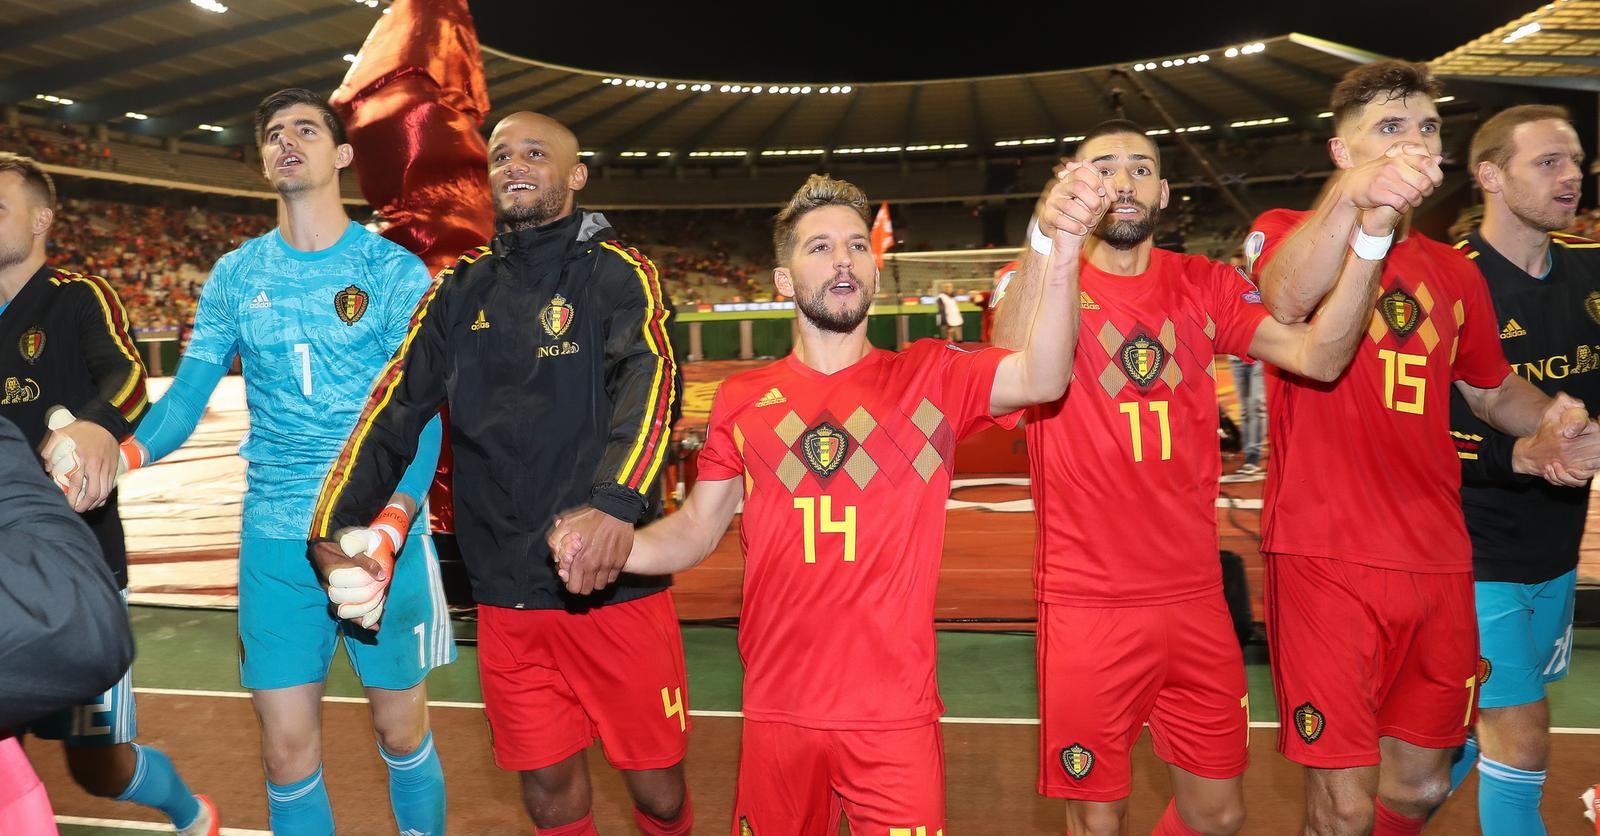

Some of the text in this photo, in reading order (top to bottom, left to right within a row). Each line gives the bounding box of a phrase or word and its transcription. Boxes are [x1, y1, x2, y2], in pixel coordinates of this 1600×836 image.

[1500, 329, 1527, 340] adidas
[294, 343, 313, 396] 1
[1378, 349, 1427, 415] 15
[1119, 400, 1172, 463] 11
[793, 495, 857, 564] 14
[413, 622, 426, 669] 1
[660, 686, 687, 733] 4
